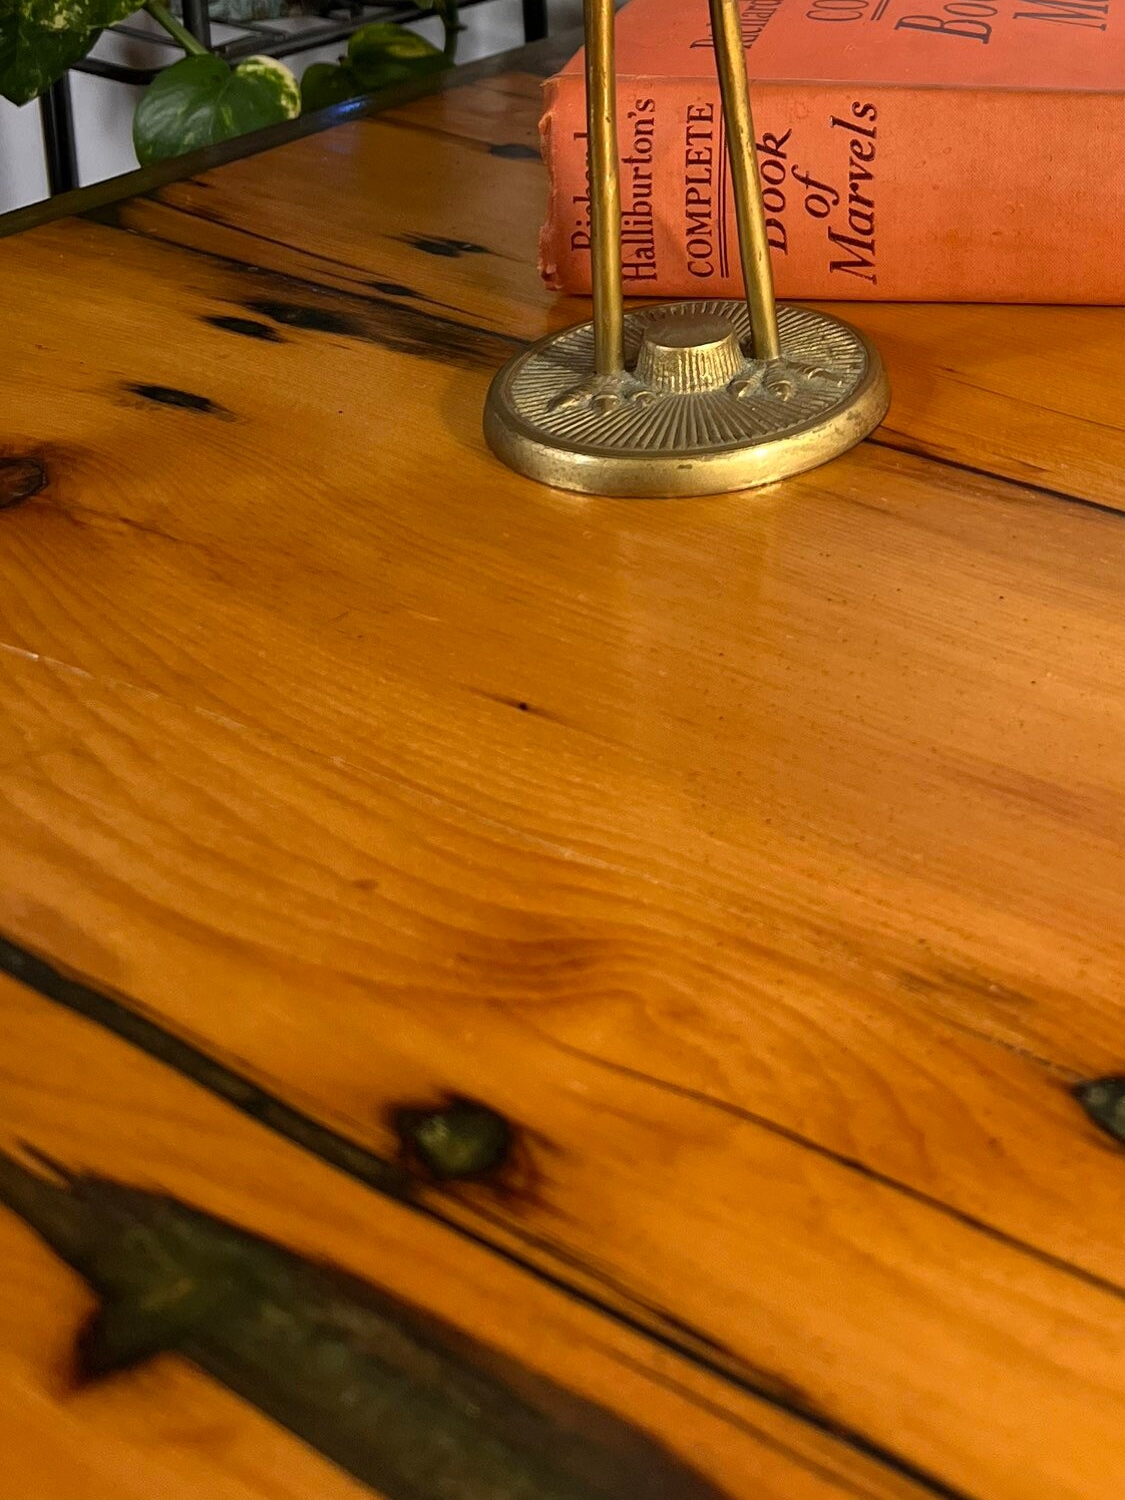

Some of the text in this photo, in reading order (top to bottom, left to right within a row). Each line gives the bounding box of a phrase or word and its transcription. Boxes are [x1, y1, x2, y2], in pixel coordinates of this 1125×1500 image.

[620, 98, 658, 281] Halliburton's
[685, 102, 714, 278] COMPLETE
[791, 164, 840, 219] of
[827, 100, 878, 285] Marvels
